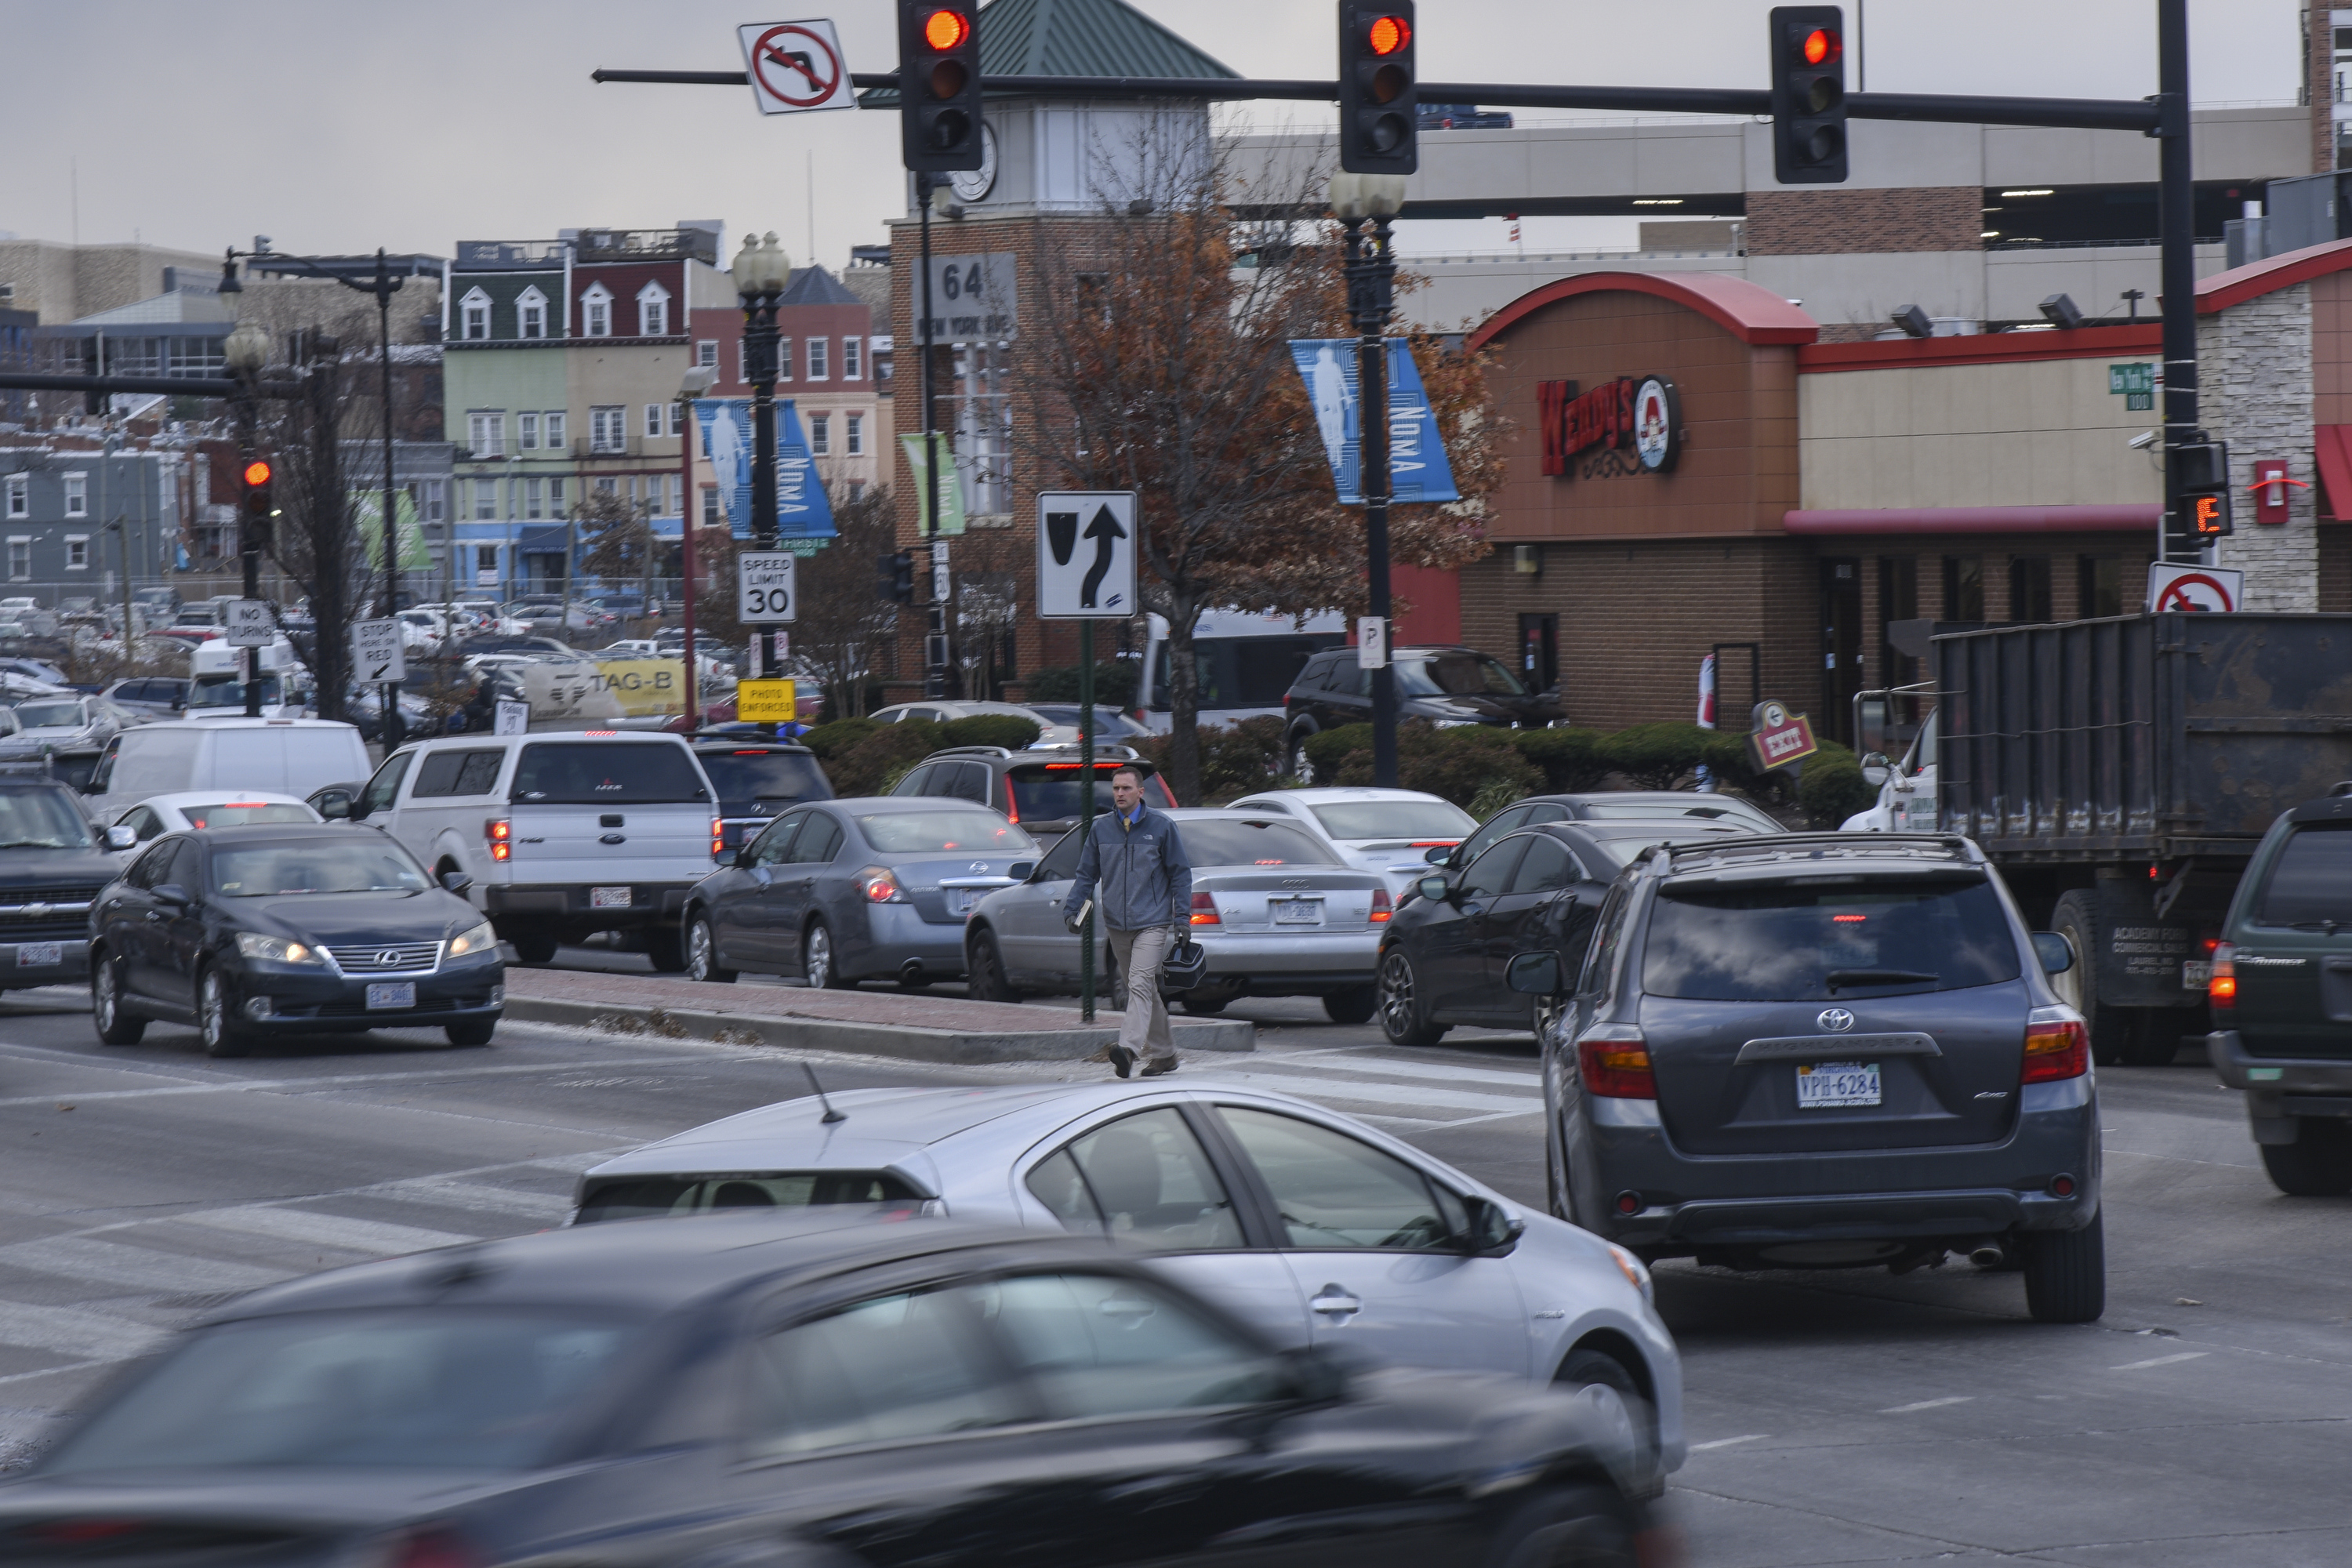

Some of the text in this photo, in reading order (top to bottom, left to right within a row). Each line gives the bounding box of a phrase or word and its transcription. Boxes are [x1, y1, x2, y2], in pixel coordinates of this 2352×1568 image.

[943, 263, 984, 300] 64
[949, 315, 982, 335] YORK
[743, 559, 791, 572] SPEED
[747, 573, 786, 586] LIMIT
[746, 588, 789, 614] 30
[238, 608, 261, 620] NO
[229, 625, 272, 638] TURNS
[360, 623, 394, 637] STOP
[361, 637, 397, 648] HERE ON
[365, 649, 393, 662] RED
[588, 670, 673, 692] TAG-B
[750, 688, 783, 699] PHOTO
[742, 702, 793, 713] ENFORCED
[1764, 726, 1804, 759] EXIT
[2113, 927, 2188, 941] ACADEMY FORD
[2112, 942, 2189, 953] COMMERCIAL SALES
[1758, 1038, 1911, 1053] HIGHLANDER
[1818, 1065, 1861, 1075] VIRGINIA
[1800, 1073, 1880, 1097] VPH-6284
[1973, 1091, 2009, 1099] 4WD
